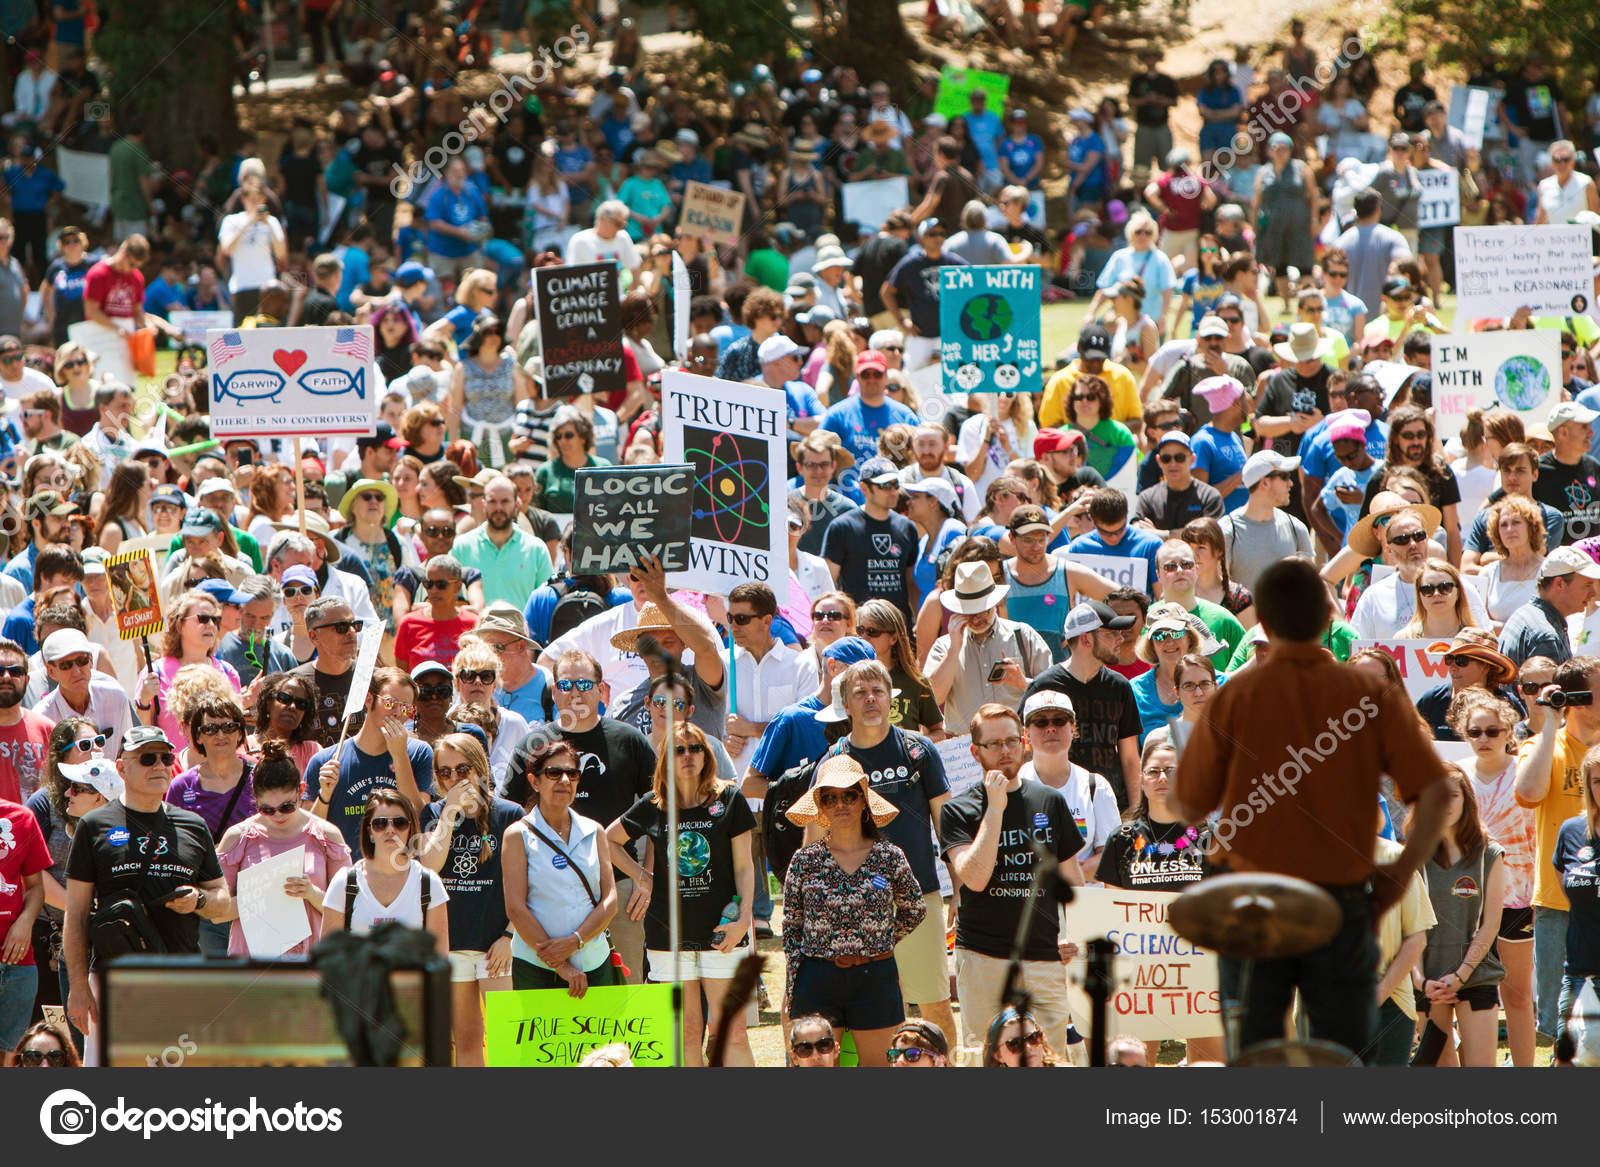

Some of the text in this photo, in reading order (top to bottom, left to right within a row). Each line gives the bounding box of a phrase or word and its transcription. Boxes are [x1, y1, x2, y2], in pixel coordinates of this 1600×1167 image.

[1463, 232, 1504, 248] There
[547, 271, 609, 296] CLIMATE
[944, 268, 1034, 290] I'M WITH
[1513, 278, 1590, 294] REASONABLE
[550, 291, 609, 315] CHANGE
[556, 308, 607, 330] DENIAL
[1017, 338, 1038, 349] AND
[972, 344, 1000, 362] HER
[1439, 347, 1468, 363] I'M
[231, 380, 279, 390] DARWIN
[313, 378, 347, 387] FAITH
[1438, 370, 1482, 386] WITH
[215, 414, 369, 426] THERE IS NO CONTROVERSY
[670, 391, 779, 437] TRUTH
[584, 474, 689, 496] LOGIC
[588, 499, 660, 517] IS ALL
[593, 518, 654, 540] WE
[580, 542, 685, 571] HAVE
[689, 542, 769, 582] WINS
[867, 559, 900, 569] EMORY
[346, 777, 373, 796] THERE'S
[677, 821, 713, 831] MARCHING
[1004, 851, 1034, 866] NOT
[112, 862, 141, 873] MARCH
[162, 864, 194, 876] SCIENCE
[1132, 874, 1202, 885] #marchforscience
[1567, 876, 1592, 888] There
[1136, 963, 1191, 988] NOT
[1106, 991, 1221, 1015] OLITICS
[508, 1015, 653, 1045] TRUE SCIENCE
[608, 1040, 664, 1061] VES
